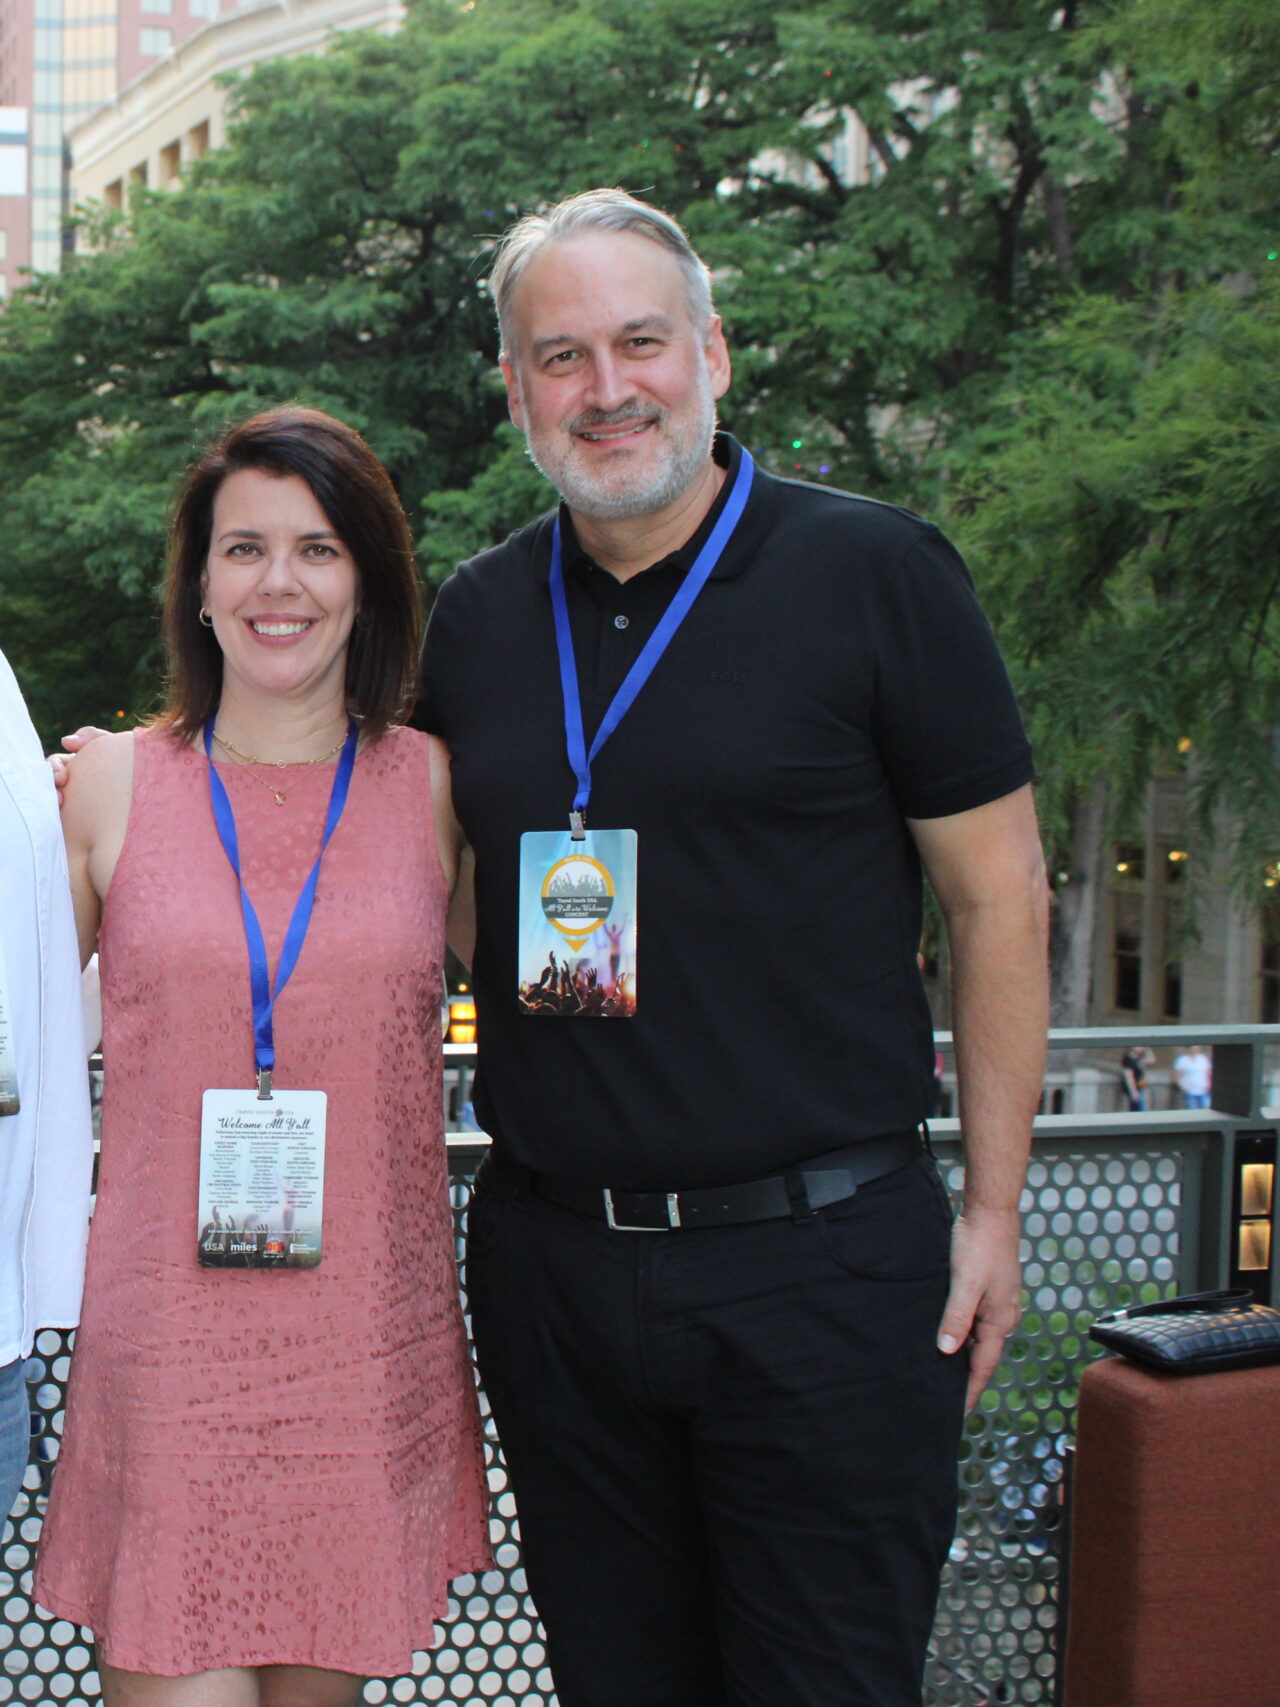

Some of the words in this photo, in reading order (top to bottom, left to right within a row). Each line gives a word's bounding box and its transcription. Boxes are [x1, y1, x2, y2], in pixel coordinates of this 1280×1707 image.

[217, 1116, 263, 1129] Welcome
[265, 1116, 283, 1129] All
[230, 1242, 257, 1252] miles
